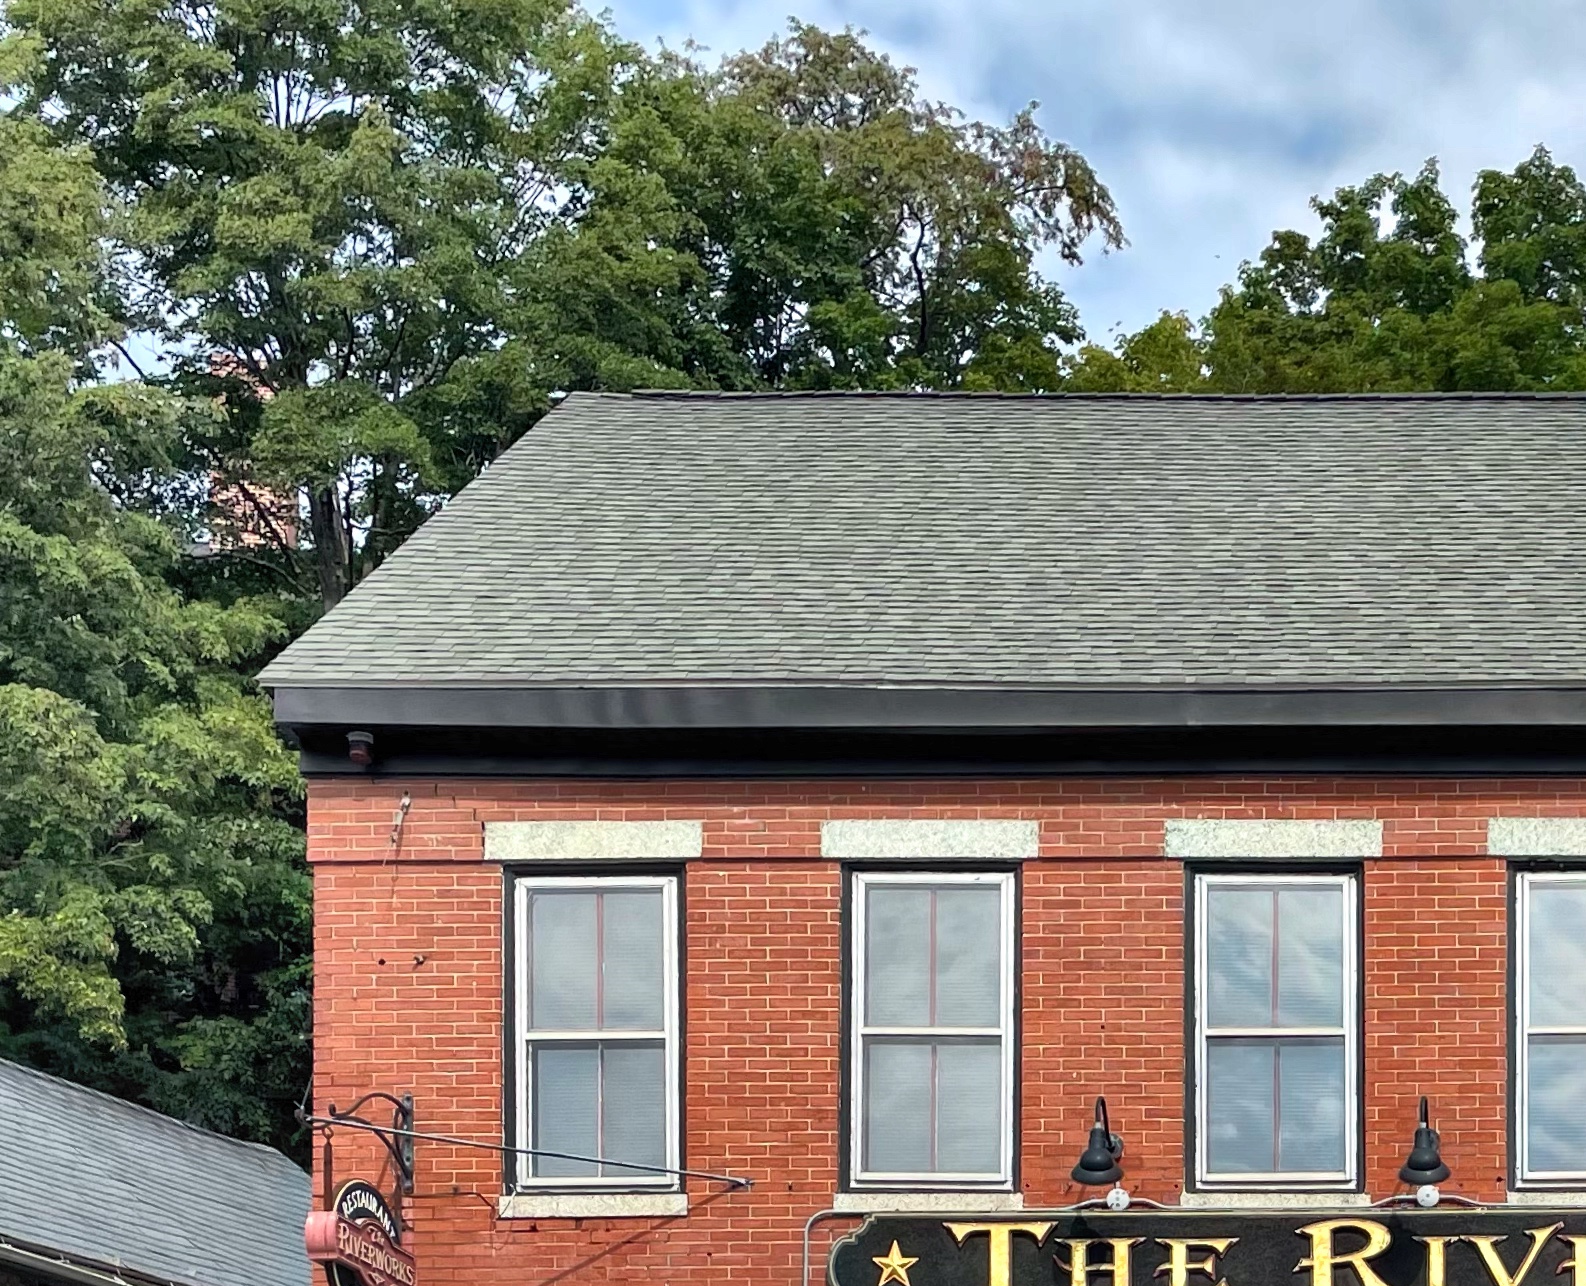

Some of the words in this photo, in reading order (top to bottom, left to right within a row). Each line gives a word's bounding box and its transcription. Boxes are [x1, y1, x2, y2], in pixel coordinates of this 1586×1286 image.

[341, 1190, 396, 1239] RESTAURANT
[367, 1225, 386, 1247] The
[337, 1223, 415, 1286] RIVERWORKS
